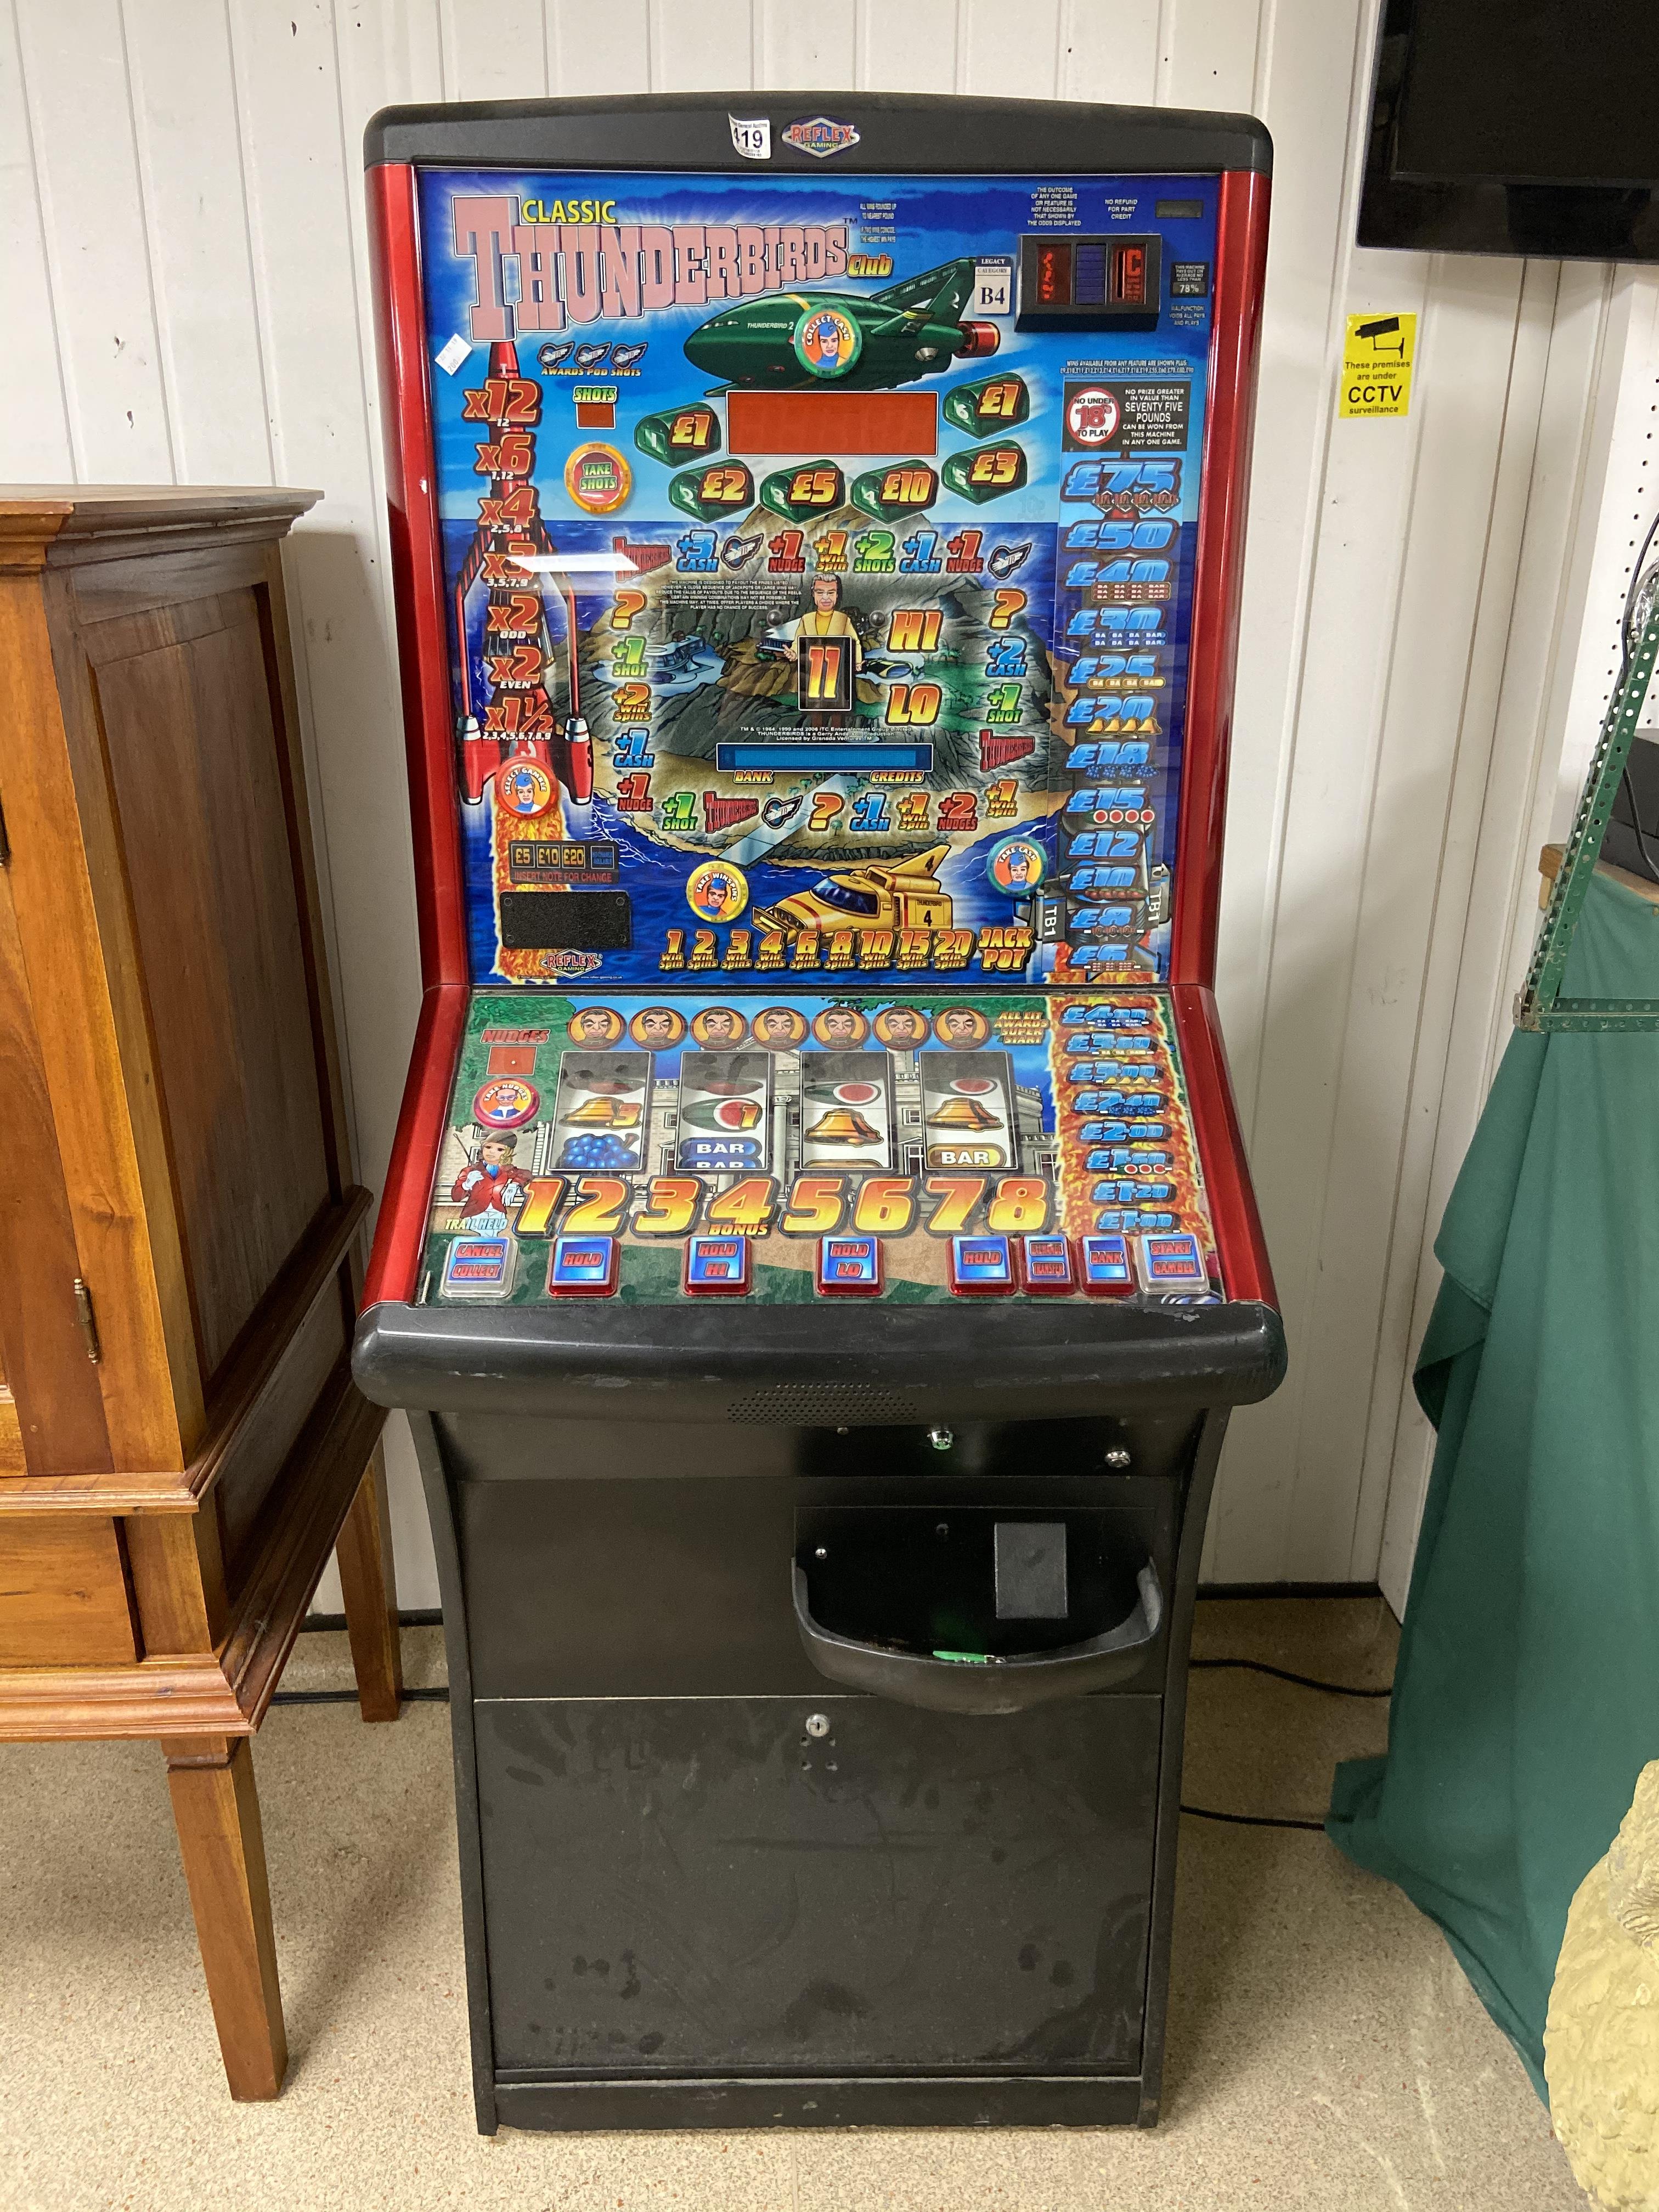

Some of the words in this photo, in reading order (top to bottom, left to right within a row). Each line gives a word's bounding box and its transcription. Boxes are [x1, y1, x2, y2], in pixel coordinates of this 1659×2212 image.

[791, 125, 854, 143] REFLEX
[523, 200, 617, 224] CLASSIC
[453, 195, 848, 342] THUNDERBIRDS
[848, 254, 892, 276] Club
[980, 286, 1006, 305] B4
[1180, 284, 1199, 293] 78%
[806, 315, 832, 346] COLLECT
[833, 318, 850, 341] CASH
[1372, 360, 1410, 370] premises
[573, 387, 617, 402] SHOTS
[1348, 385, 1402, 403] CCTV
[1125, 402, 1162, 412] SEVENTY
[1165, 402, 1183, 412] FIVE
[1136, 413, 1171, 422] POUNDS
[671, 413, 710, 448] £1
[583, 462, 612, 476] TAKE
[972, 451, 1019, 484] £3
[579, 476, 617, 492] SHOTS
[1065, 461, 1176, 495] £75
[701, 470, 747, 501] £2
[790, 470, 837, 503] £5
[881, 471, 927, 503] £10
[1065, 521, 1173, 549] £50
[676, 558, 720, 572] CASH
[769, 558, 805, 572] NUDGE
[500, 630, 526, 639] ODD
[888, 610, 944, 652] HI
[612, 663, 648, 677] SHOT
[500, 680, 531, 689] EVEN
[886, 684, 941, 724] LO
[505, 768, 520, 795] SELECT
[522, 768, 547, 792] GAMBLE
[735, 771, 772, 783] BANK
[871, 771, 924, 783] CREDITS
[938, 819, 978, 831] NUDGES
[1068, 830, 1141, 857] £12
[516, 848, 530, 864] £5
[539, 849, 558, 864] £10
[564, 849, 584, 865] £20
[515, 871, 540, 881] INSERT
[543, 872, 561, 881] NOTE
[564, 873, 579, 881] FOR
[582, 873, 612, 882] CHANGE
[696, 874, 711, 893] TAKE
[712, 873, 737, 902] WINSPINS
[1043, 906, 1058, 938] TB1
[667, 930, 684, 954] 1
[693, 930, 716, 954] 2
[728, 930, 751, 954] 3
[760, 930, 784, 954] 4
[797, 930, 819, 954] 6
[830, 930, 854, 954] 8
[860, 929, 893, 957] 10
[900, 929, 931, 957] 15
[934, 929, 973, 957] 20
[979, 928, 1034, 948] JACK
[546, 954, 597, 967] REFLEX
[981, 949, 1025, 969] POT
[994, 1019, 1049, 1028] AWARDS
[481, 1030, 550, 1043] NUDGES
[696, 1143, 744, 1154] BAR
[941, 1152, 989, 1164] BAR
[517, 1178, 565, 1234] 1
[563, 1178, 627, 1234] 2
[634, 1178, 699, 1234] 3
[709, 1178, 773, 1226] 4
[783, 1178, 841, 1232] 5
[853, 1178, 911, 1232] 6
[928, 1178, 987, 1232] 7
[989, 1178, 1046, 1232] 8
[445, 1218, 478, 1230] TRAIL
[478, 1218, 508, 1230] HELD
[708, 1224, 769, 1235] BONUS
[456, 1244, 503, 1257] CANCEL
[698, 1243, 737, 1256] HOLD
[831, 1244, 869, 1257] HOLD
[1151, 1241, 1192, 1255] START
[563, 1252, 603, 1266] HOLD
[964, 1251, 1002, 1265] HOLD
[1090, 1251, 1123, 1264] BANK
[452, 1264, 501, 1277] COLLECT
[704, 1263, 729, 1276] HI
[837, 1263, 862, 1276] LO
[1032, 1262, 1065, 1276] TRANSFER
[1153, 1261, 1195, 1274] GAMBLE
